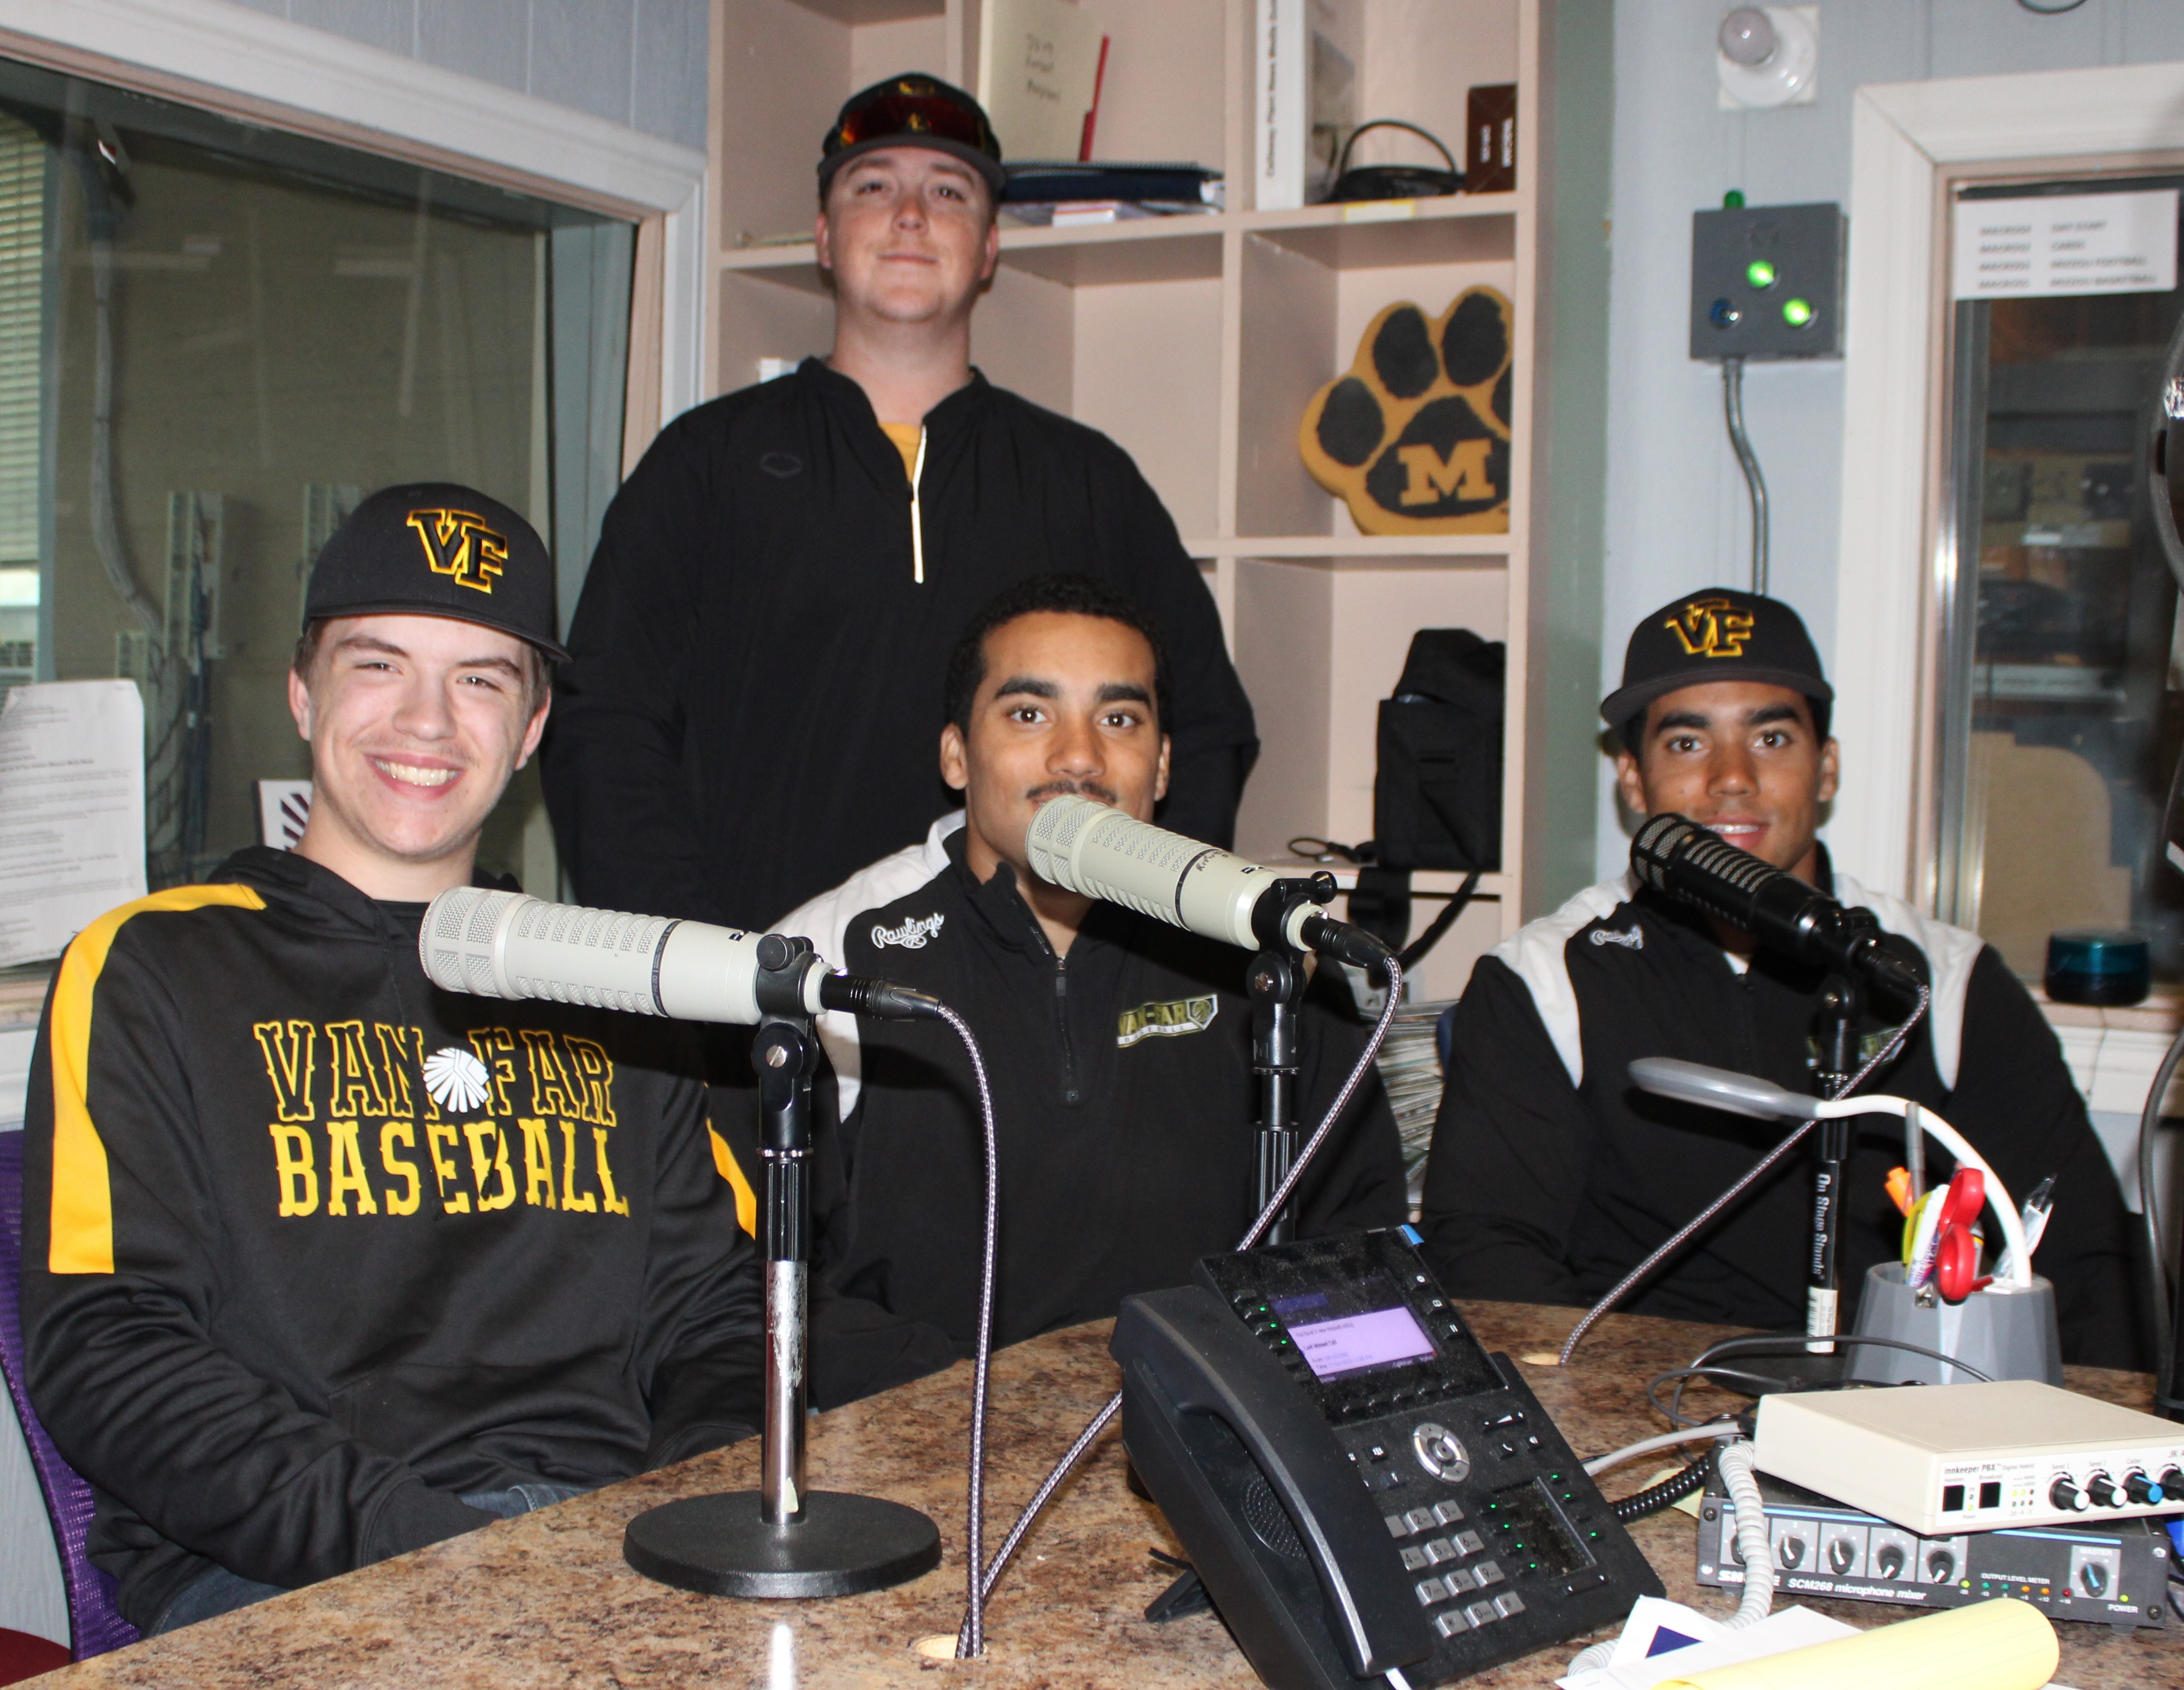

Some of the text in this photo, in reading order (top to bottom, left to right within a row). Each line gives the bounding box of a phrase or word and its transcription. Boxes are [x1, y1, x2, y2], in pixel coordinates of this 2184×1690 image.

[1398, 437, 1497, 506] M
[406, 508, 508, 594] VF
[1664, 597, 1755, 658] VF
[871, 912, 945, 949] Rawlings
[253, 1020, 618, 1127] VAN FAR
[269, 1118, 630, 1218] BASEBALL
[1816, 1173, 1831, 1192] On
[1815, 1196, 1830, 1231] Stage
[2168, 1450, 2179, 1458] JK
[1414, 1507, 1450, 1524] 2 3
[1405, 1536, 1470, 1564] 4 5 6
[2079, 1547, 2113, 1556] MASTER
[1425, 1585, 1432, 1596] 7
[1454, 1577, 1462, 1587] 8
[1482, 1568, 1489, 1577] 9
[1717, 1569, 1927, 1600] SHE SCM268 microphone mixer
[1981, 1572, 2007, 1581] OUTPUT
[2007, 1575, 2027, 1583] LEVEL
[1474, 1608, 1483, 1618] 0
[2107, 1603, 2139, 1614] POWER
